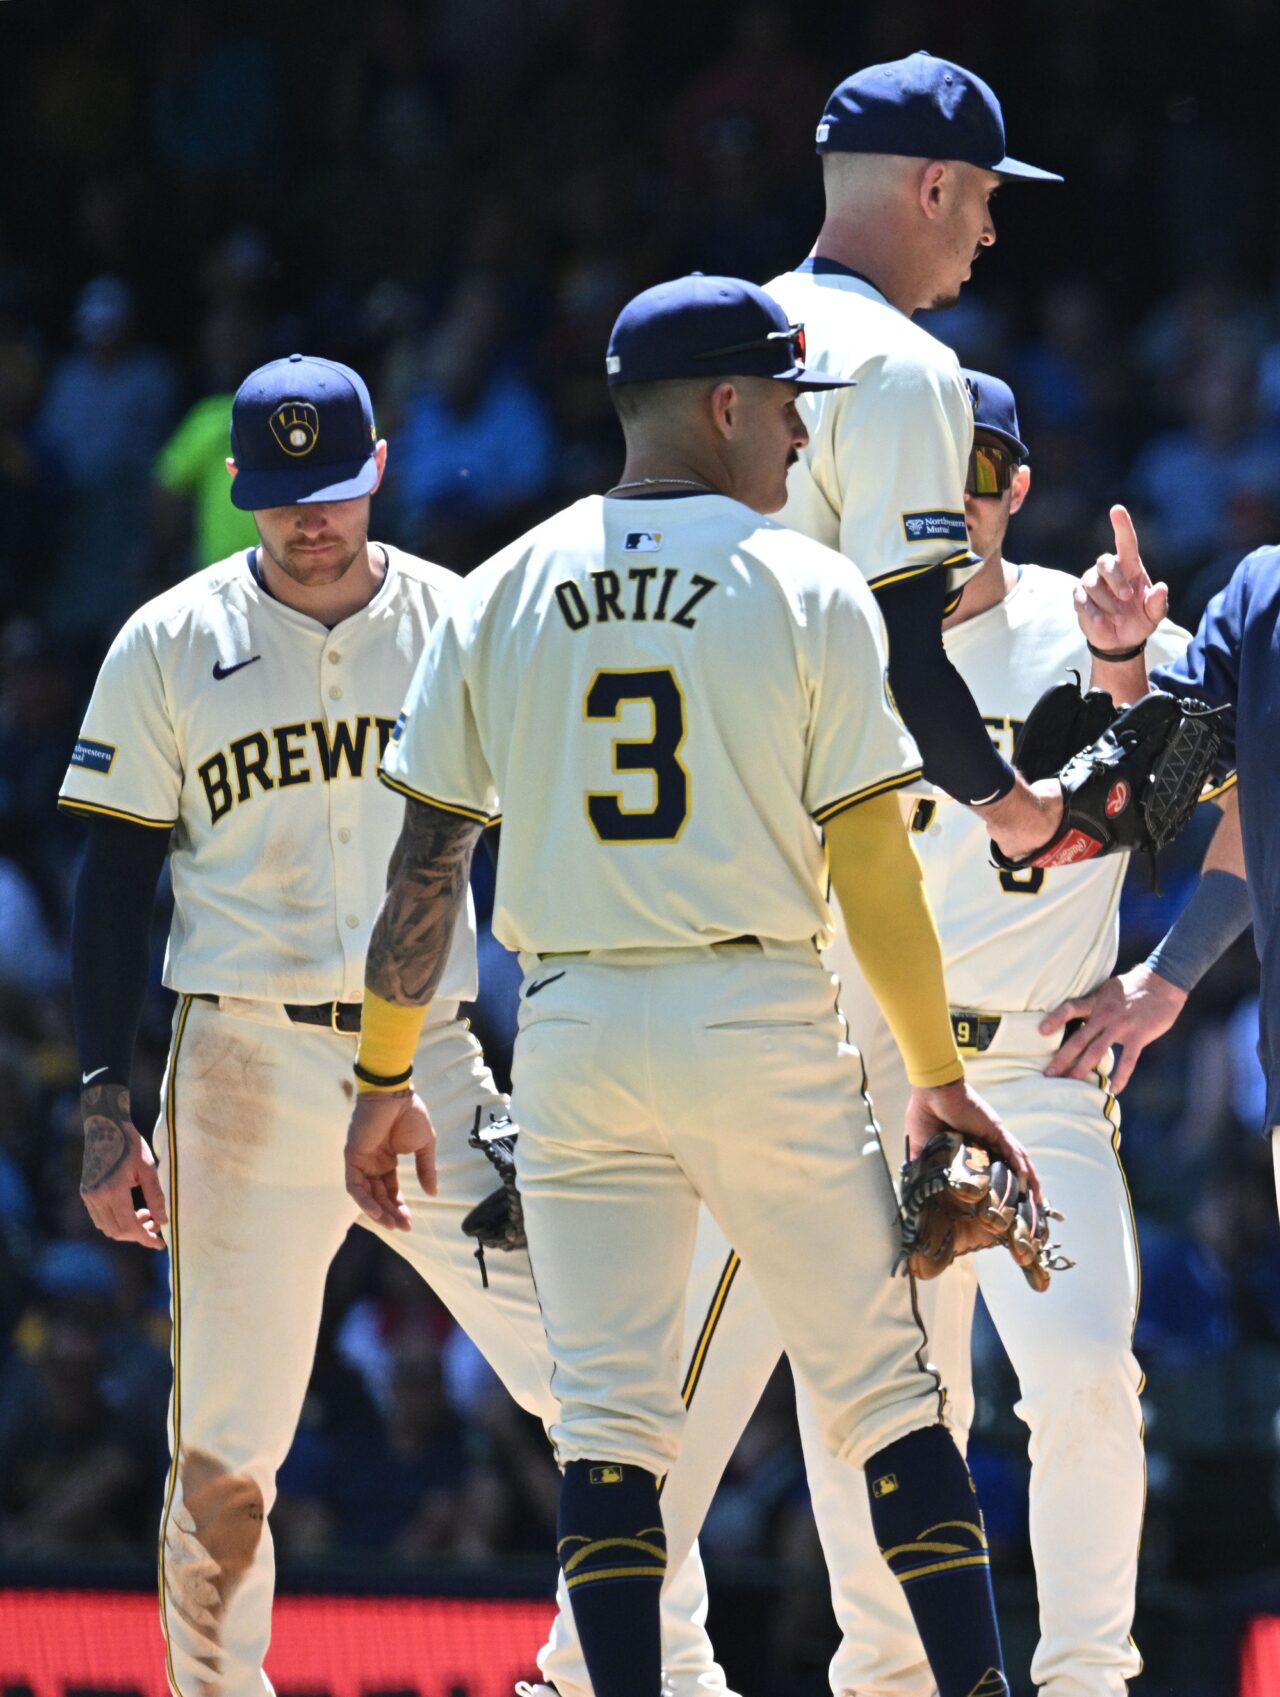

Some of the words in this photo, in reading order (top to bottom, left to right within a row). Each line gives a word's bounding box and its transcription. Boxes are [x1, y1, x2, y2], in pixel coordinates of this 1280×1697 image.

[554, 567, 719, 632] ORTIZ
[582, 666, 692, 845] 3
[957, 1021, 970, 1043] 9
